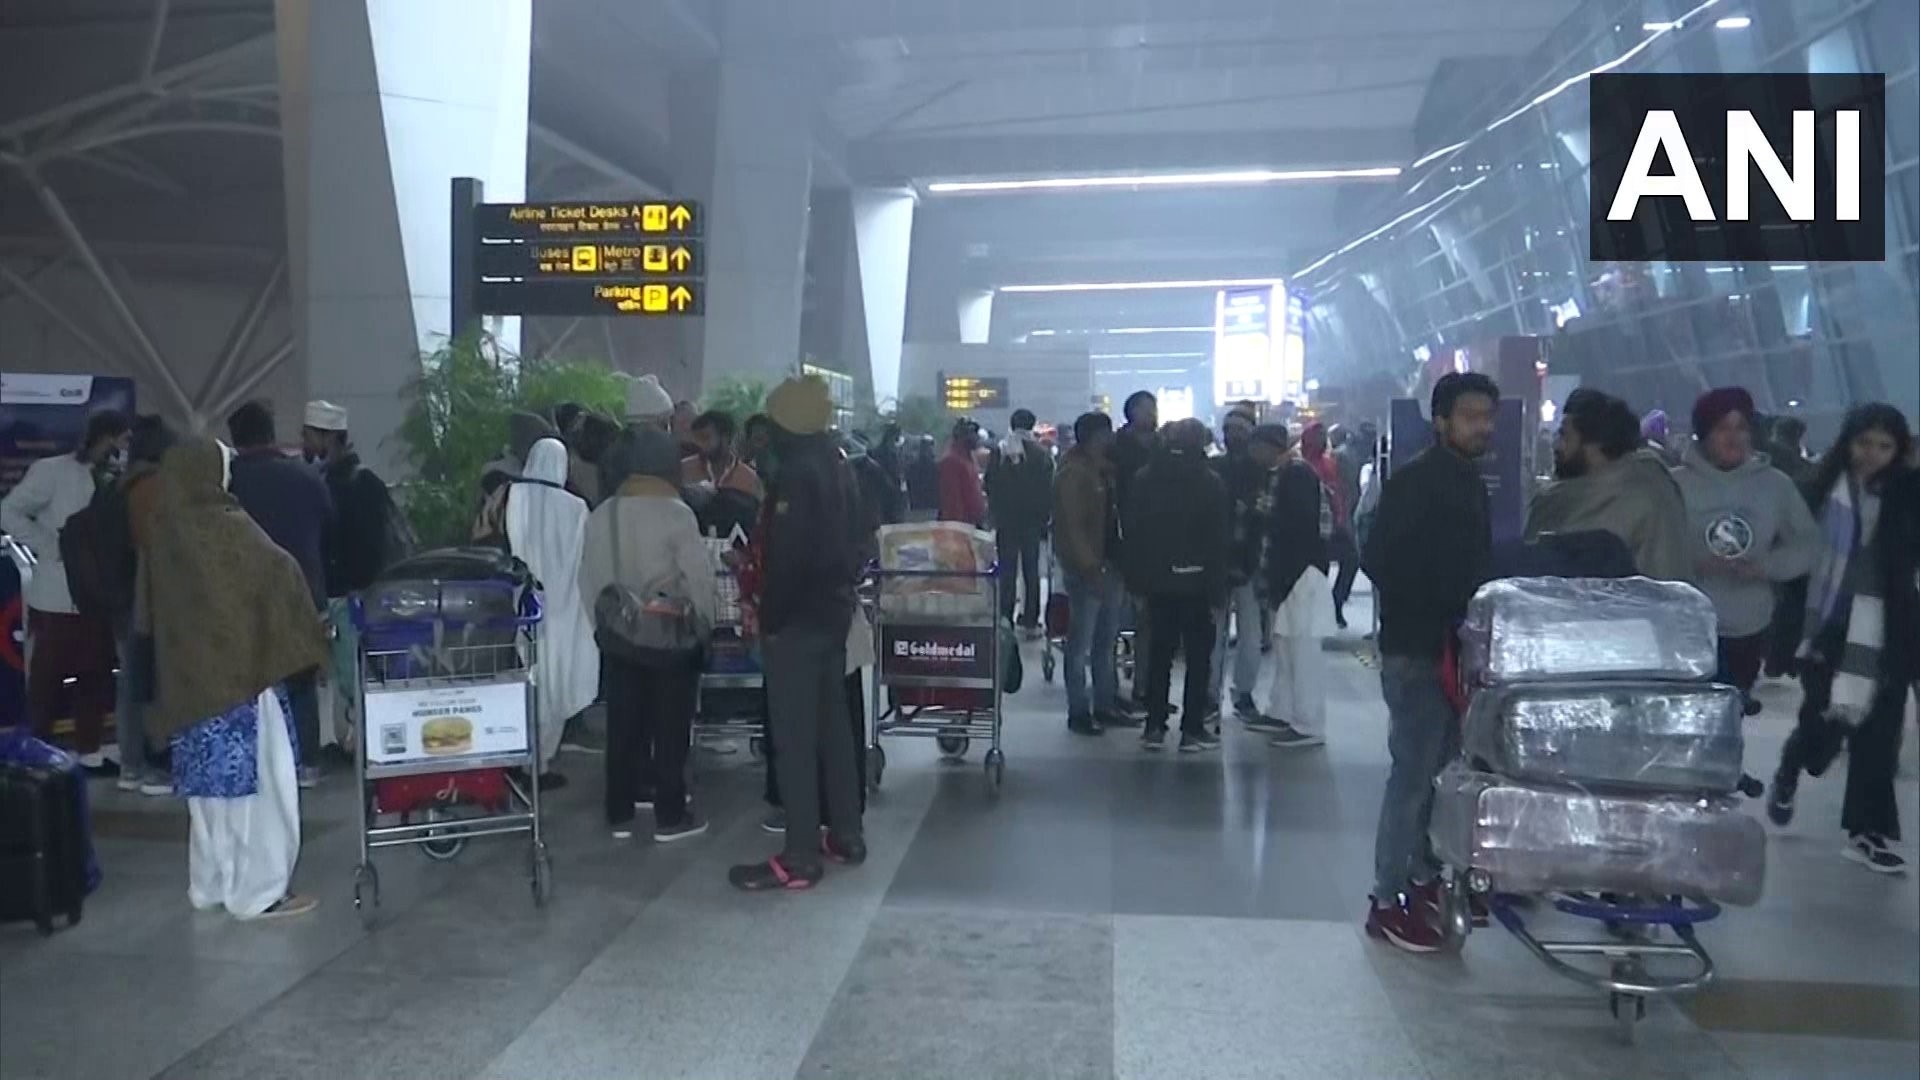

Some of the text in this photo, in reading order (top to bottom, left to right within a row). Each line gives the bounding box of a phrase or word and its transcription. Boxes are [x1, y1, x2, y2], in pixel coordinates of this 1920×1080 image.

[509, 205, 641, 220] Airline Ticket Desks A
[603, 245, 641, 258] Metro
[594, 285, 641, 300] Parking
[909, 640, 976, 657] Goldmedal
